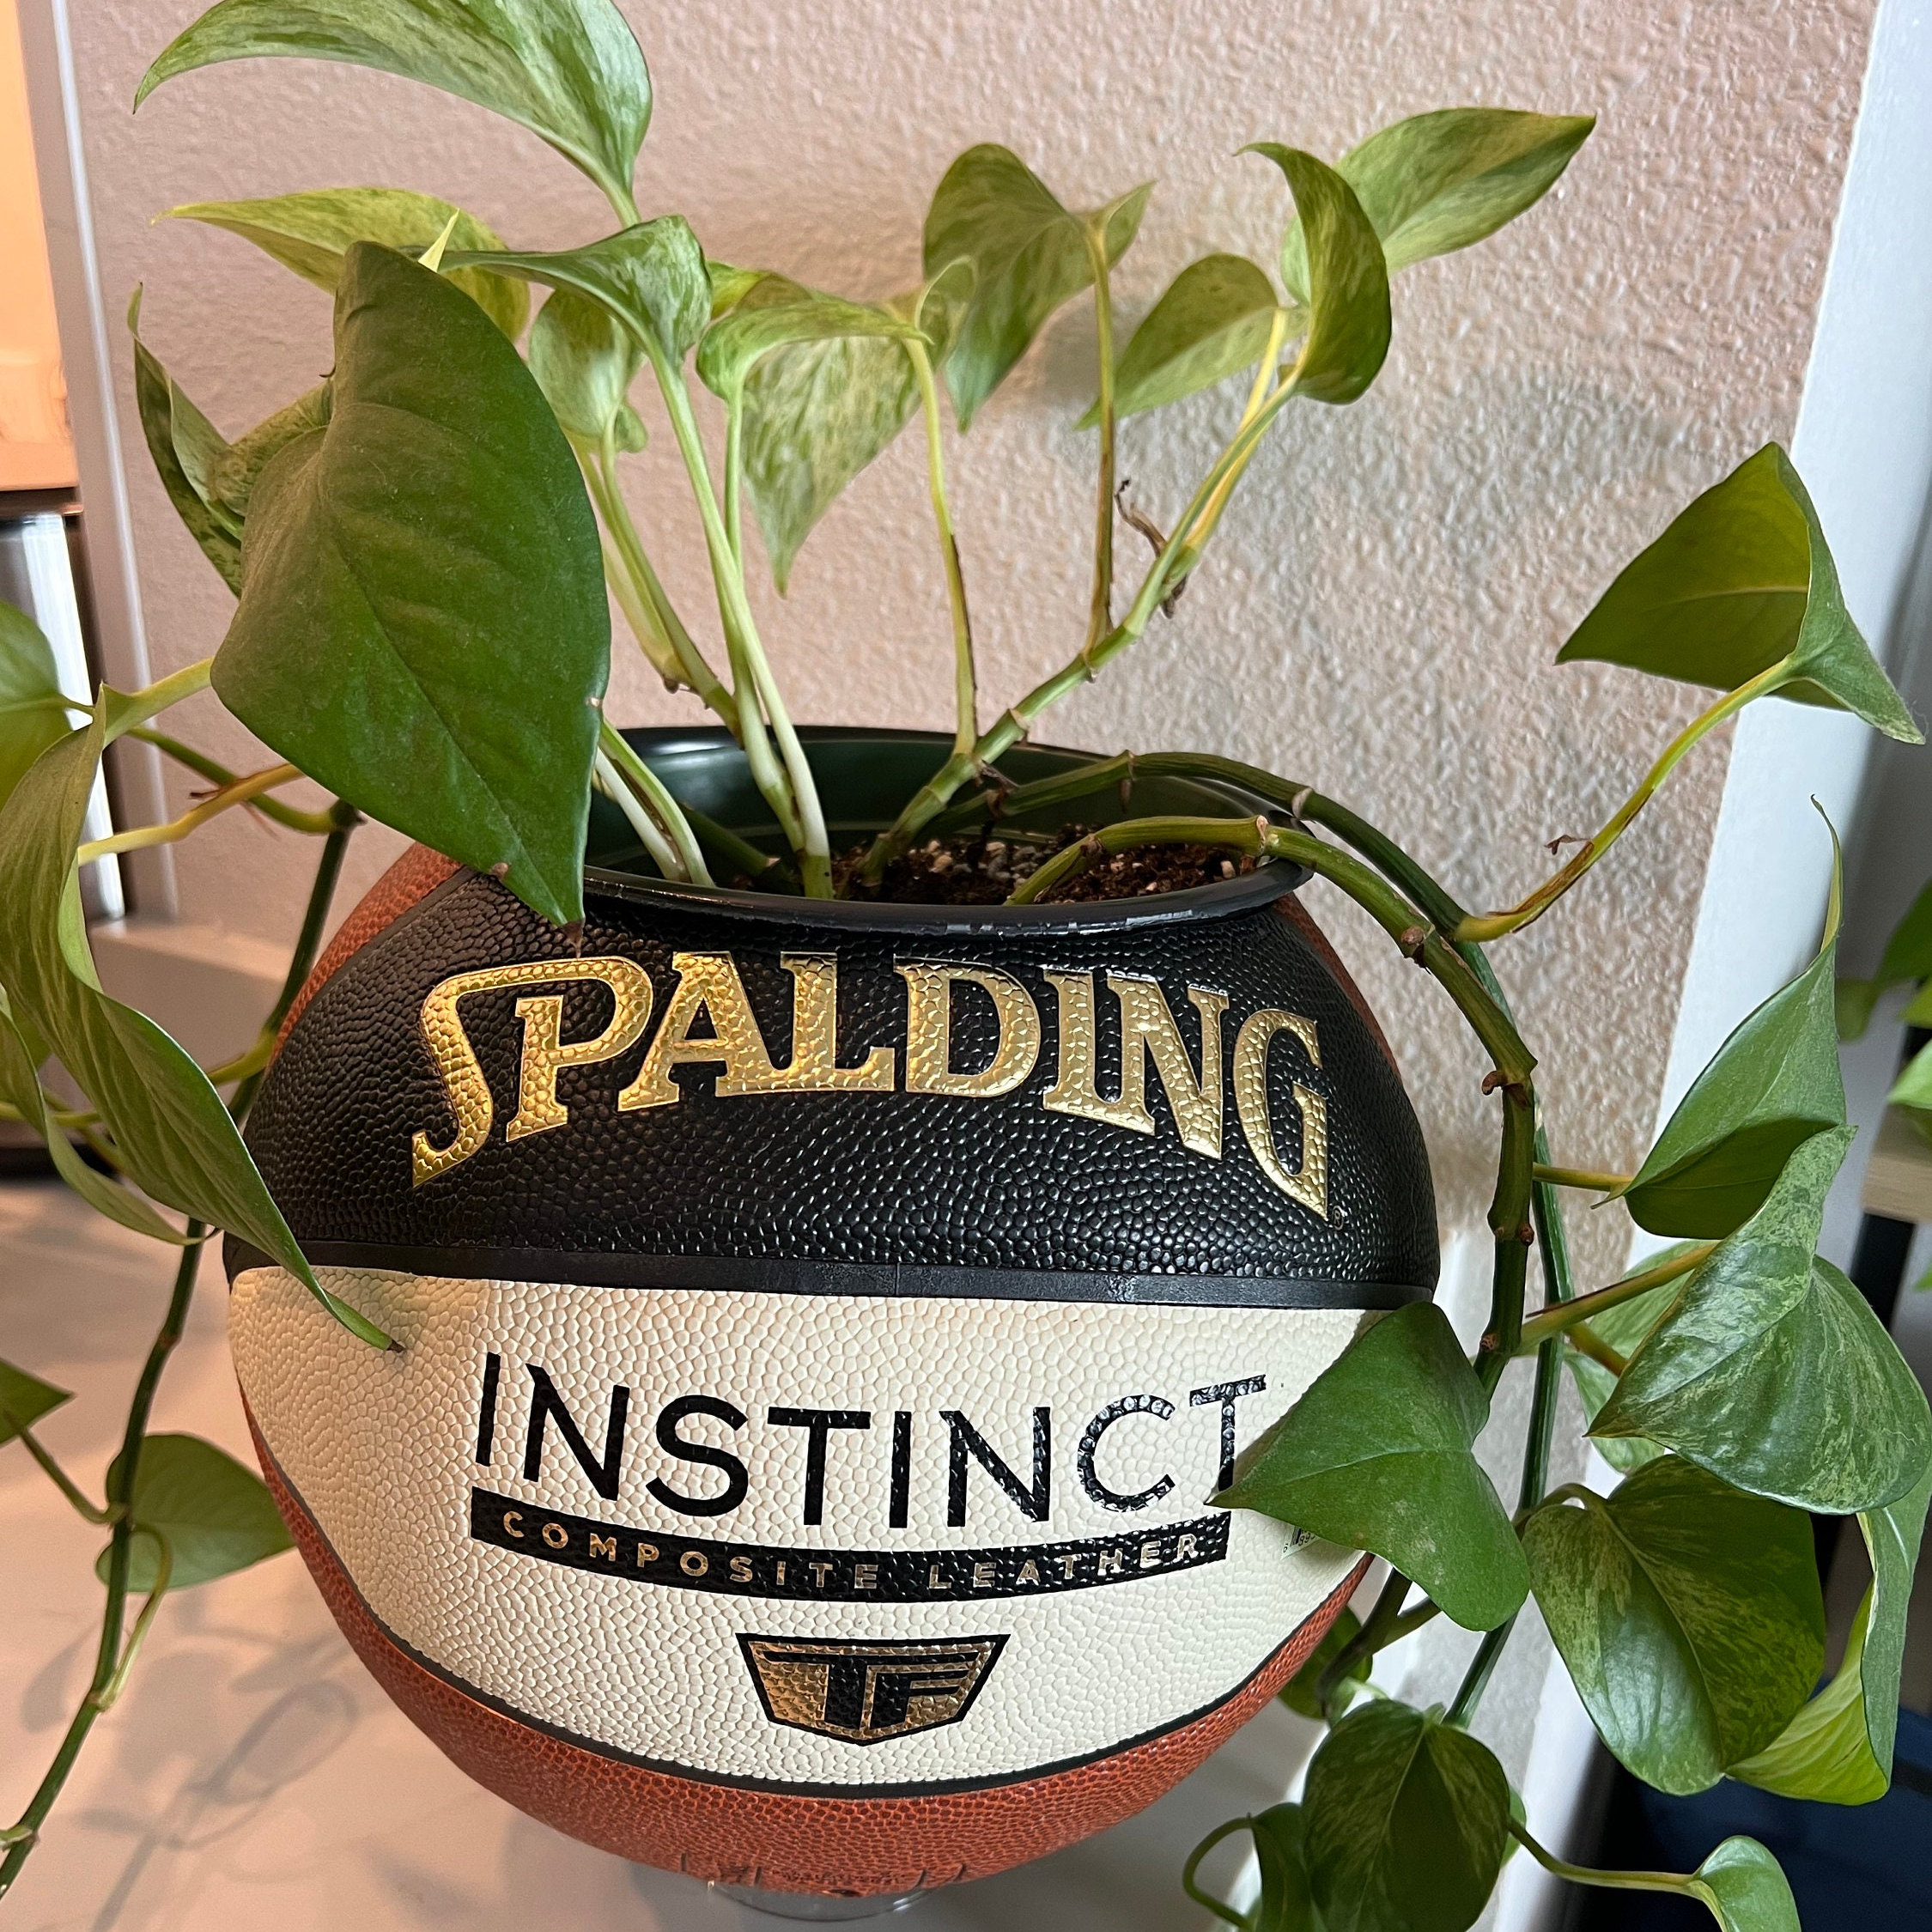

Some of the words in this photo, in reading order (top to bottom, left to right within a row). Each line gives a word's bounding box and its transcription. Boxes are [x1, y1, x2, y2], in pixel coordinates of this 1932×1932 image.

[412, 950, 1327, 1222] SPALDING
[476, 1352, 1267, 1528] INSTINCT
[502, 1510, 878, 1589] COMPOSITE
[928, 1532, 1200, 1589] LEATHER
[762, 1649, 980, 1730] TF
